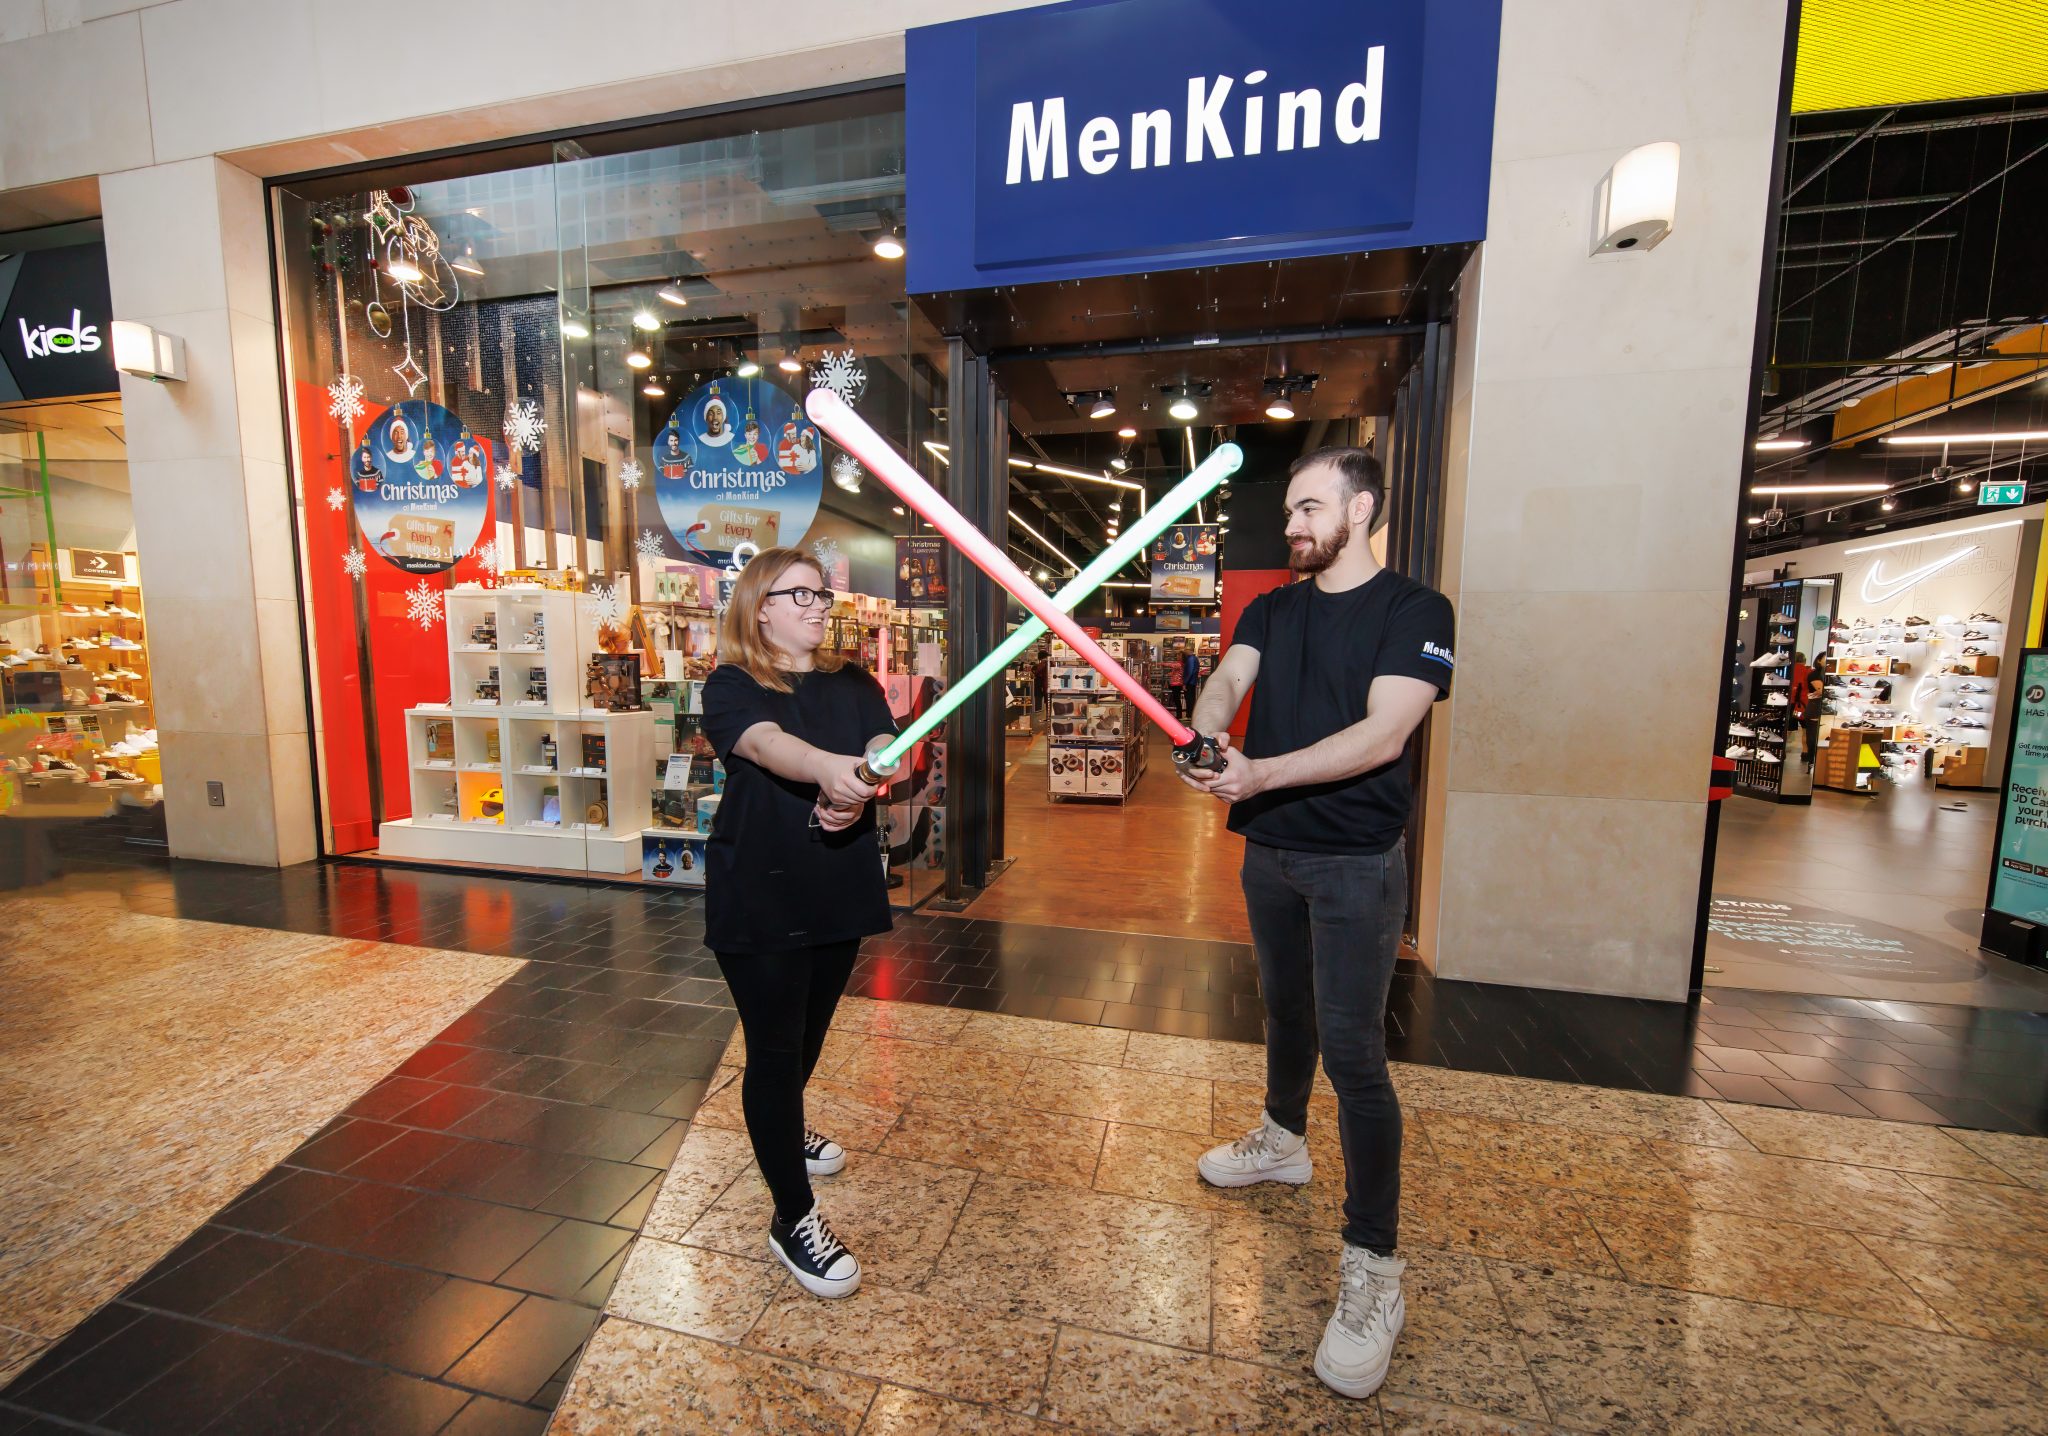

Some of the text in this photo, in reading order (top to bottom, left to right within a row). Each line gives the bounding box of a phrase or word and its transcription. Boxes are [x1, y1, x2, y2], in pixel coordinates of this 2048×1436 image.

[1006, 45, 1385, 185] MenKind
[18, 308, 102, 359] kids
[689, 467, 787, 493] Christmas
[380, 481, 459, 504] Christmas
[725, 490, 760, 500] MenKind
[719, 510, 742, 523] Gifts
[724, 523, 753, 539] Every
[1163, 562, 1204, 571] Christmas
[2027, 688, 2044, 700] JD
[2025, 708, 2045, 717] HAS
[2025, 749, 2041, 758] time
[2012, 794, 2028, 804] JD
[2017, 806, 2044, 817] your
[1715, 900, 1792, 910] STATUS
